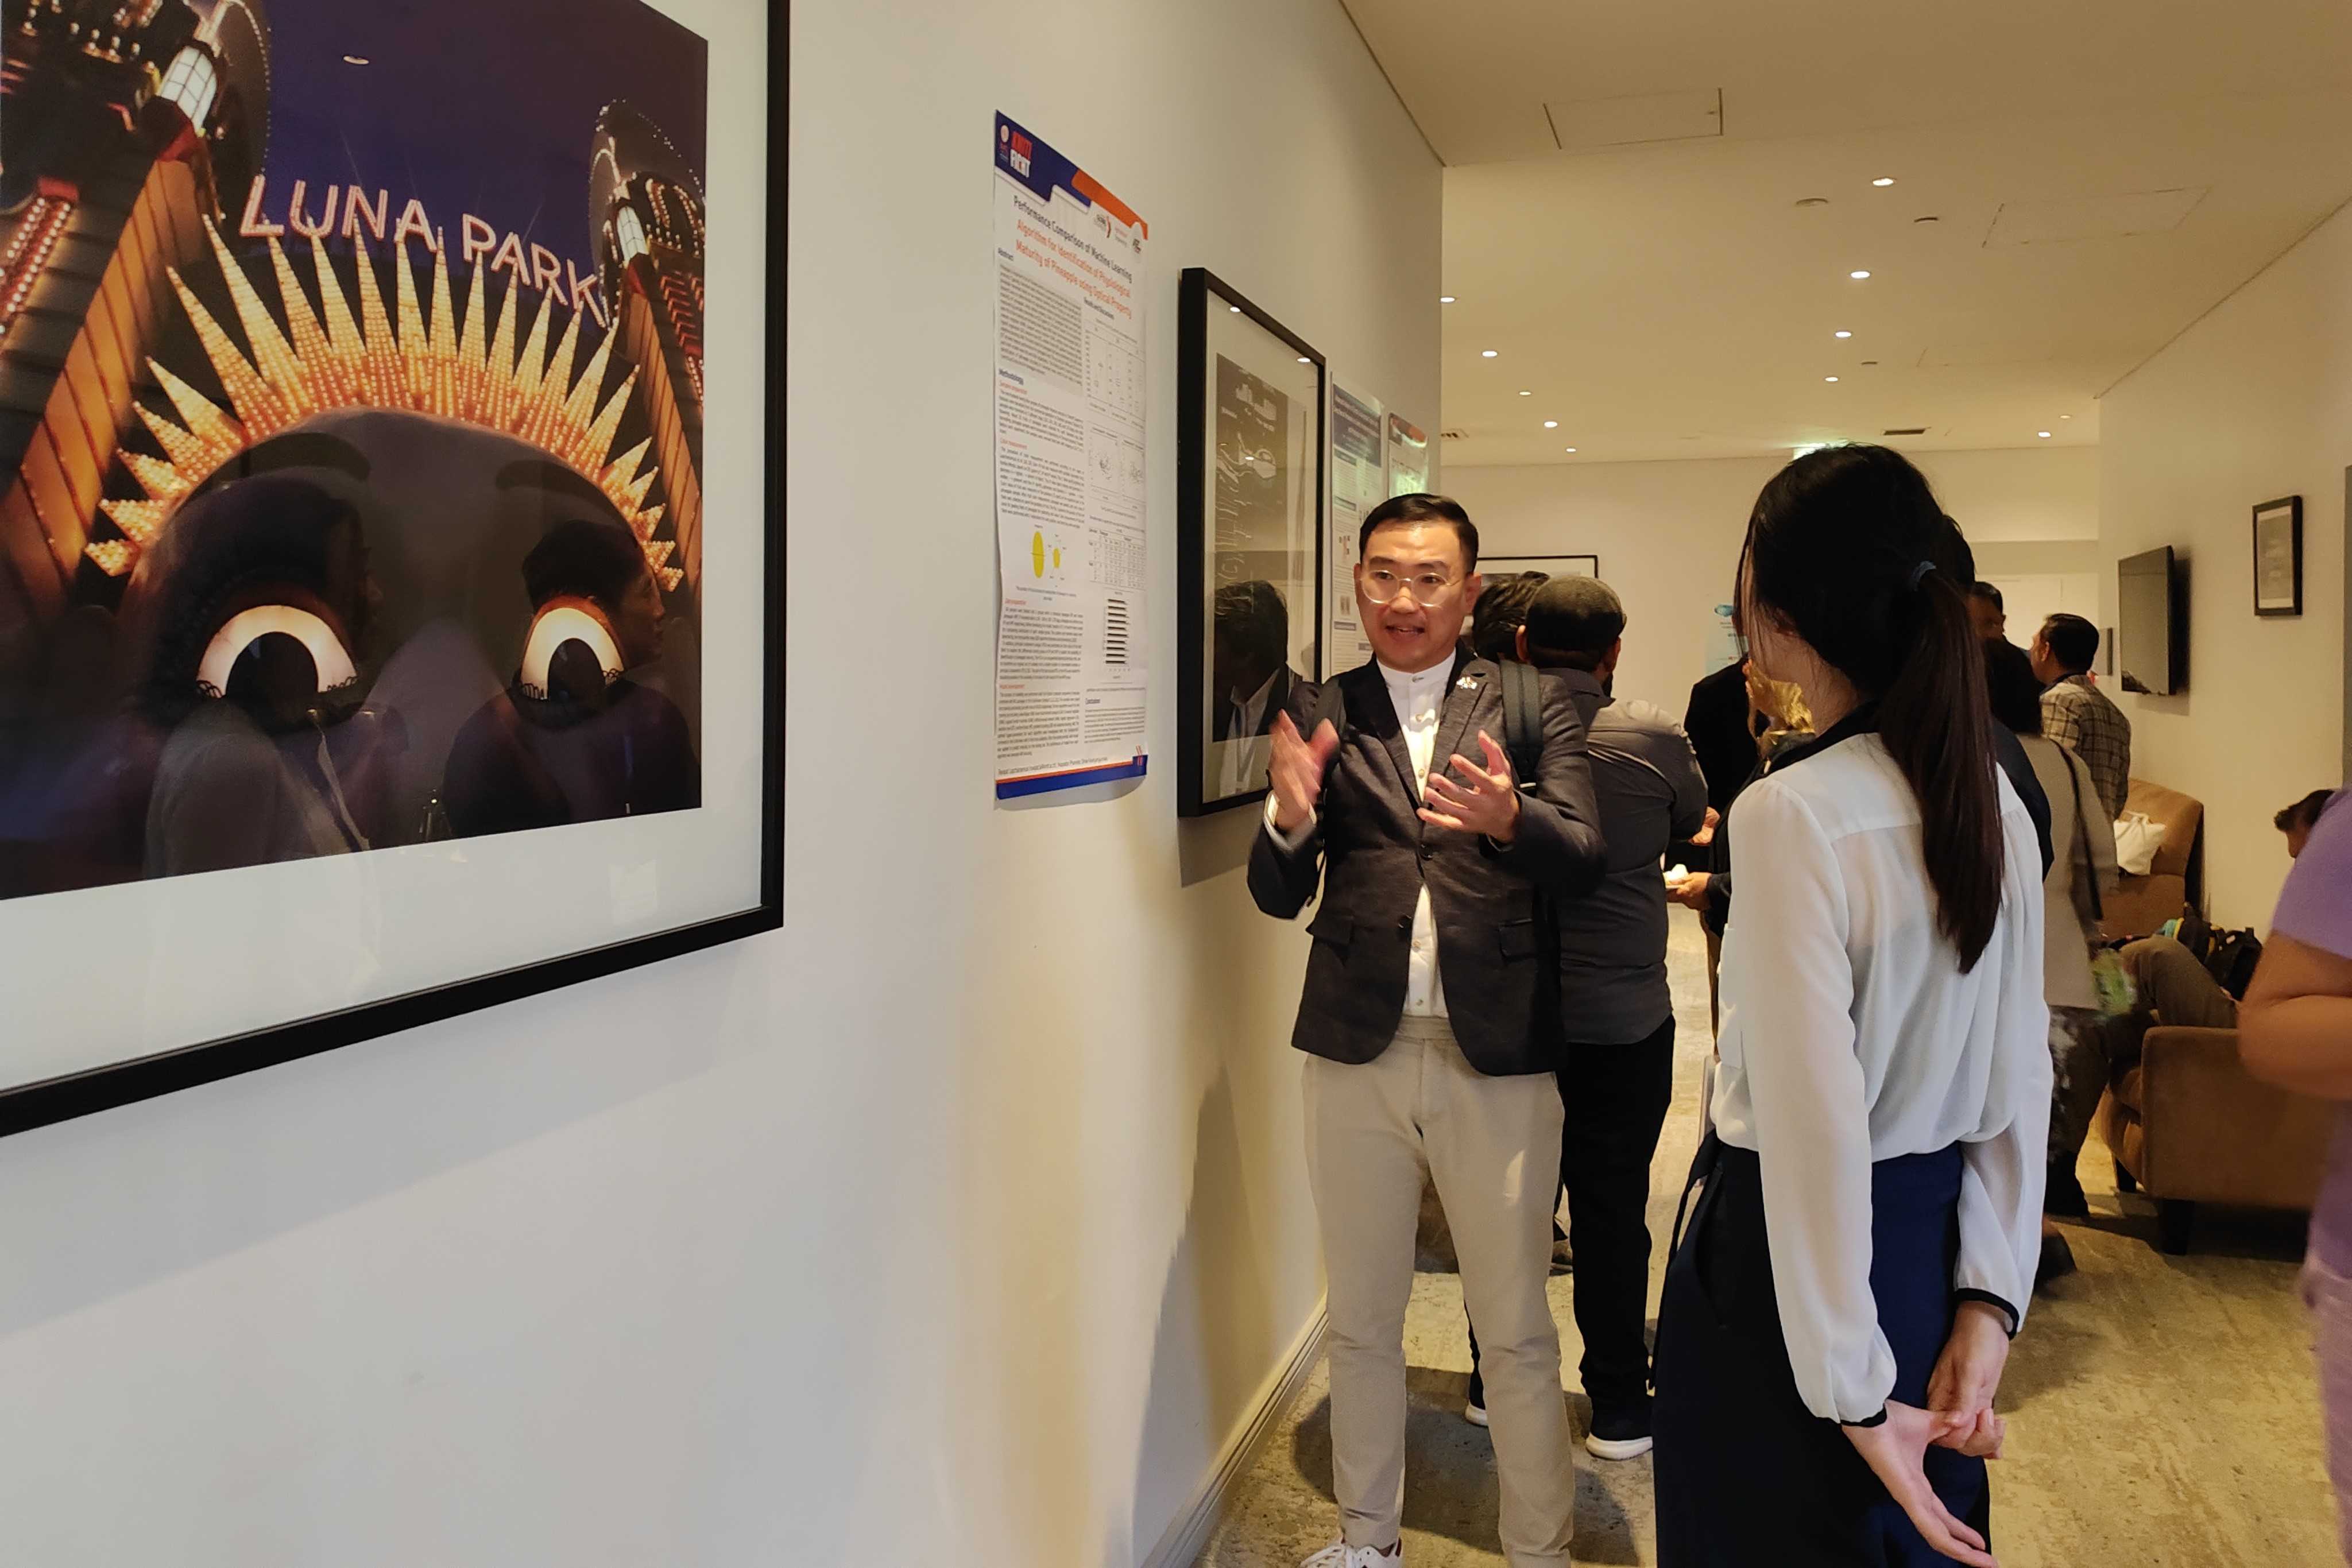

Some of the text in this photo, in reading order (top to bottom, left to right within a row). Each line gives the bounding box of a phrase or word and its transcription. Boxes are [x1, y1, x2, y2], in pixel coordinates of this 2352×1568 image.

[239, 173, 606, 328] LUNA PARK
[1013, 195, 1051, 230] Performance
[1051, 220, 1085, 250] Comparison
[1092, 247, 1110, 268] Machine
[1111, 259, 1132, 284] Learning
